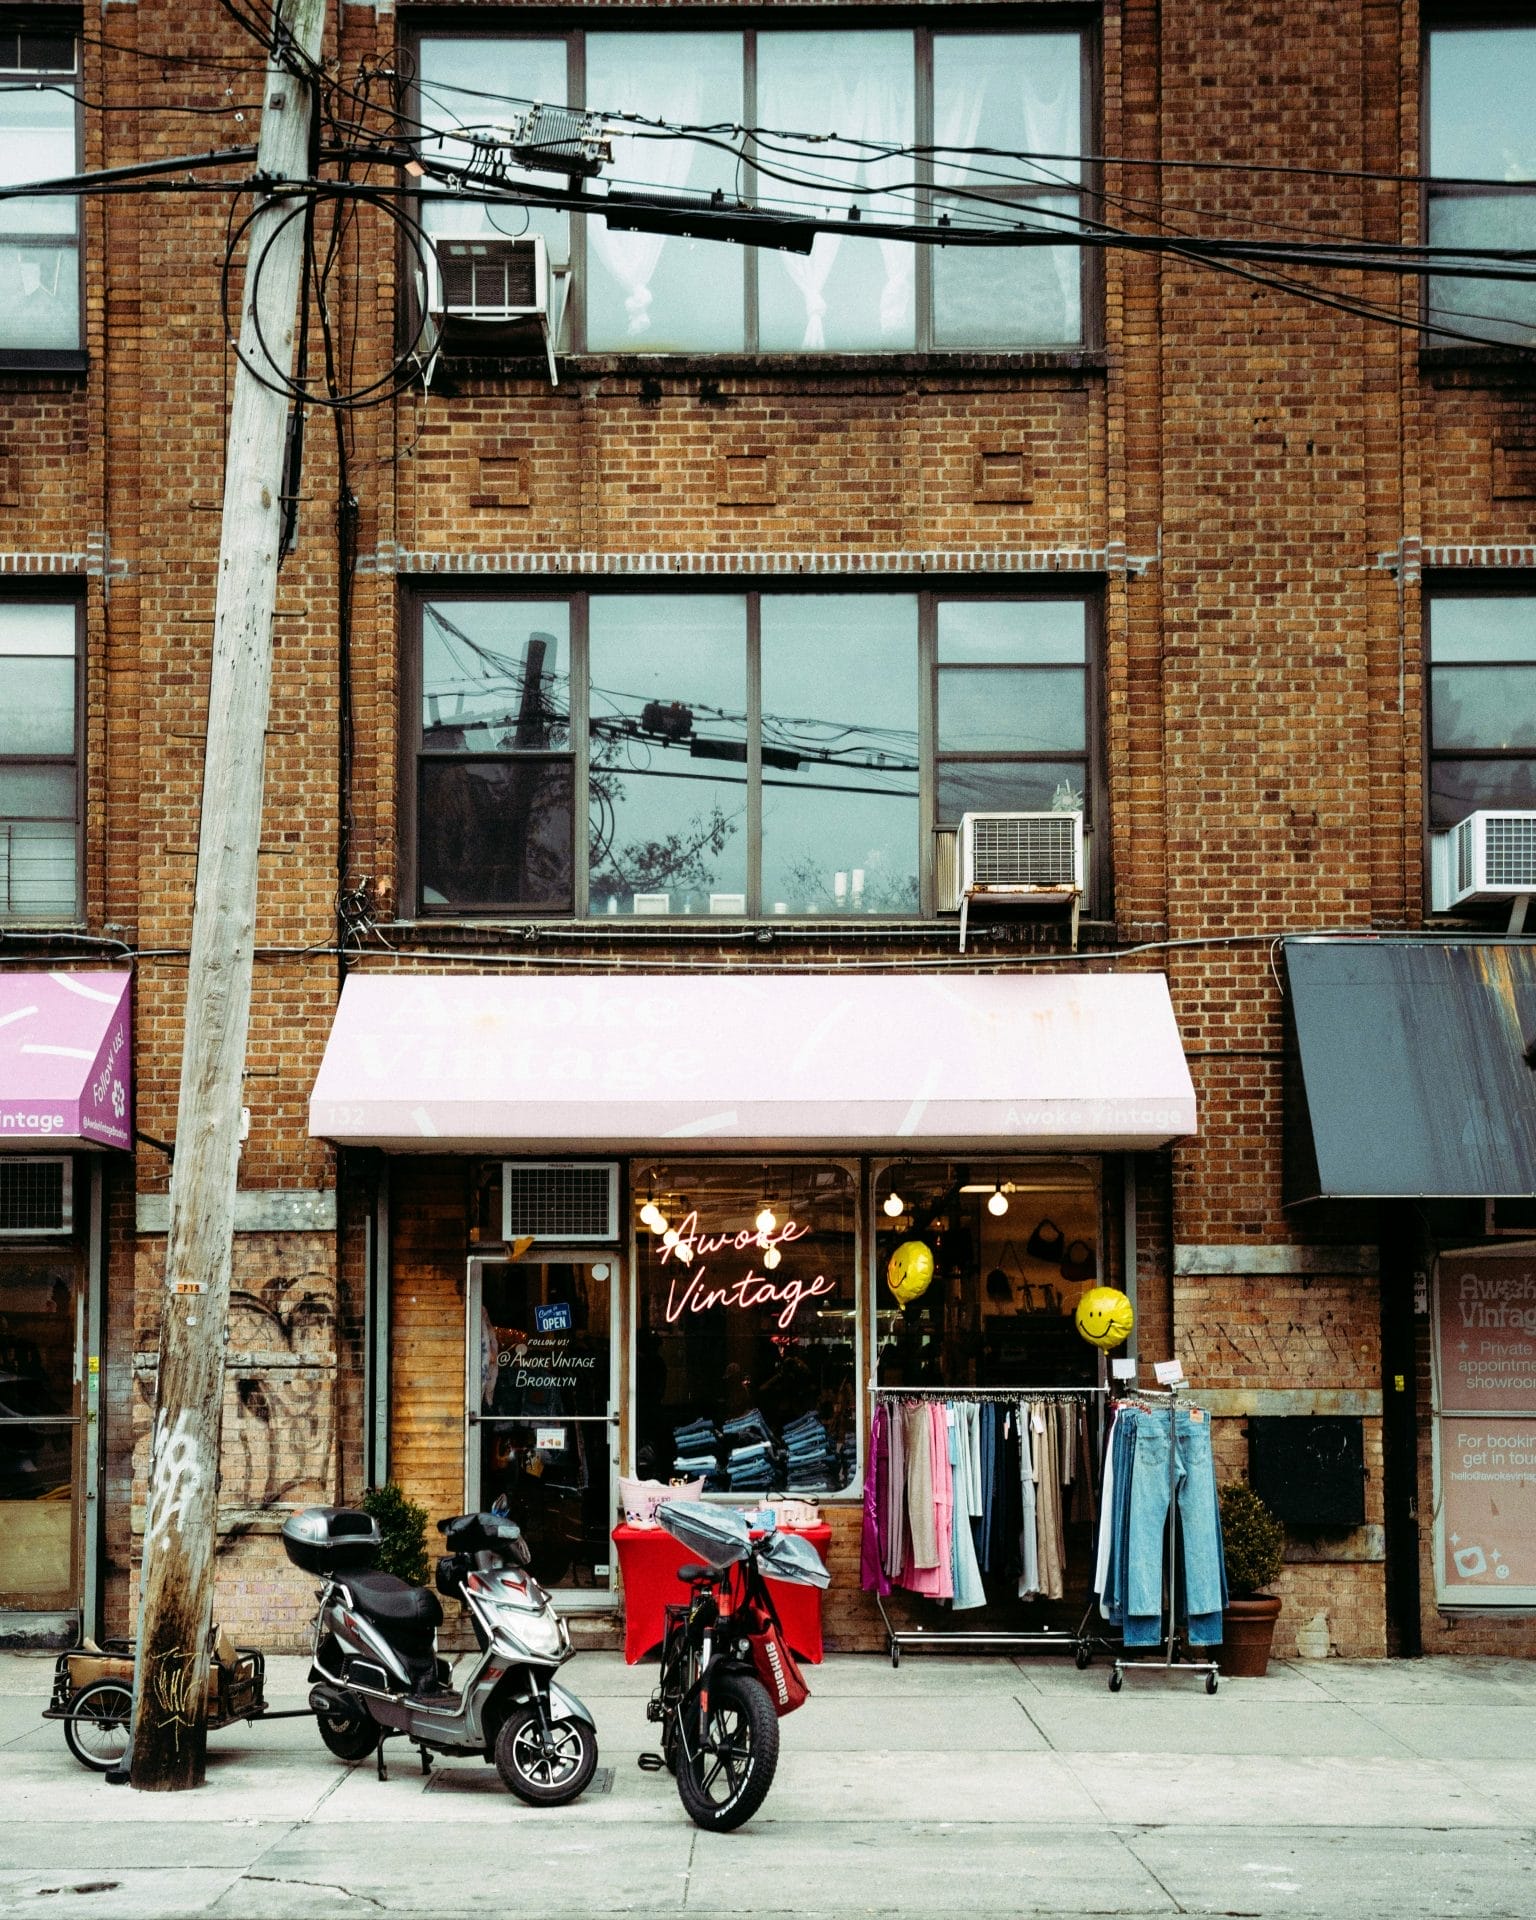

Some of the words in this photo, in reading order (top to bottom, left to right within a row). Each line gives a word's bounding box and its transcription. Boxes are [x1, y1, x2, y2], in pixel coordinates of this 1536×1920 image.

[384, 984, 681, 1027] Awoke
[93, 1048, 114, 1107] Follow
[112, 1023, 124, 1054] us!
[350, 1033, 706, 1089] Vintage
[327, 1106, 365, 1126] 132
[1006, 1106, 1081, 1126] Awoke
[1091, 1106, 1182, 1130] Vintage
[656, 1210, 810, 1267] Awoke
[666, 1266, 836, 1329] Vintage
[542, 1316, 567, 1330] OPEN
[557, 1339, 570, 1347] US!
[1480, 1341, 1533, 1356] Private
[515, 1370, 577, 1388] BROOKLYN
[1466, 1376, 1536, 1389] showroo
[1458, 1433, 1483, 1448] For
[1463, 1451, 1488, 1468] get
[1492, 1451, 1505, 1465] in
[1509, 1451, 1536, 1465] tou
[765, 1641, 789, 1705] GRUBHUB
